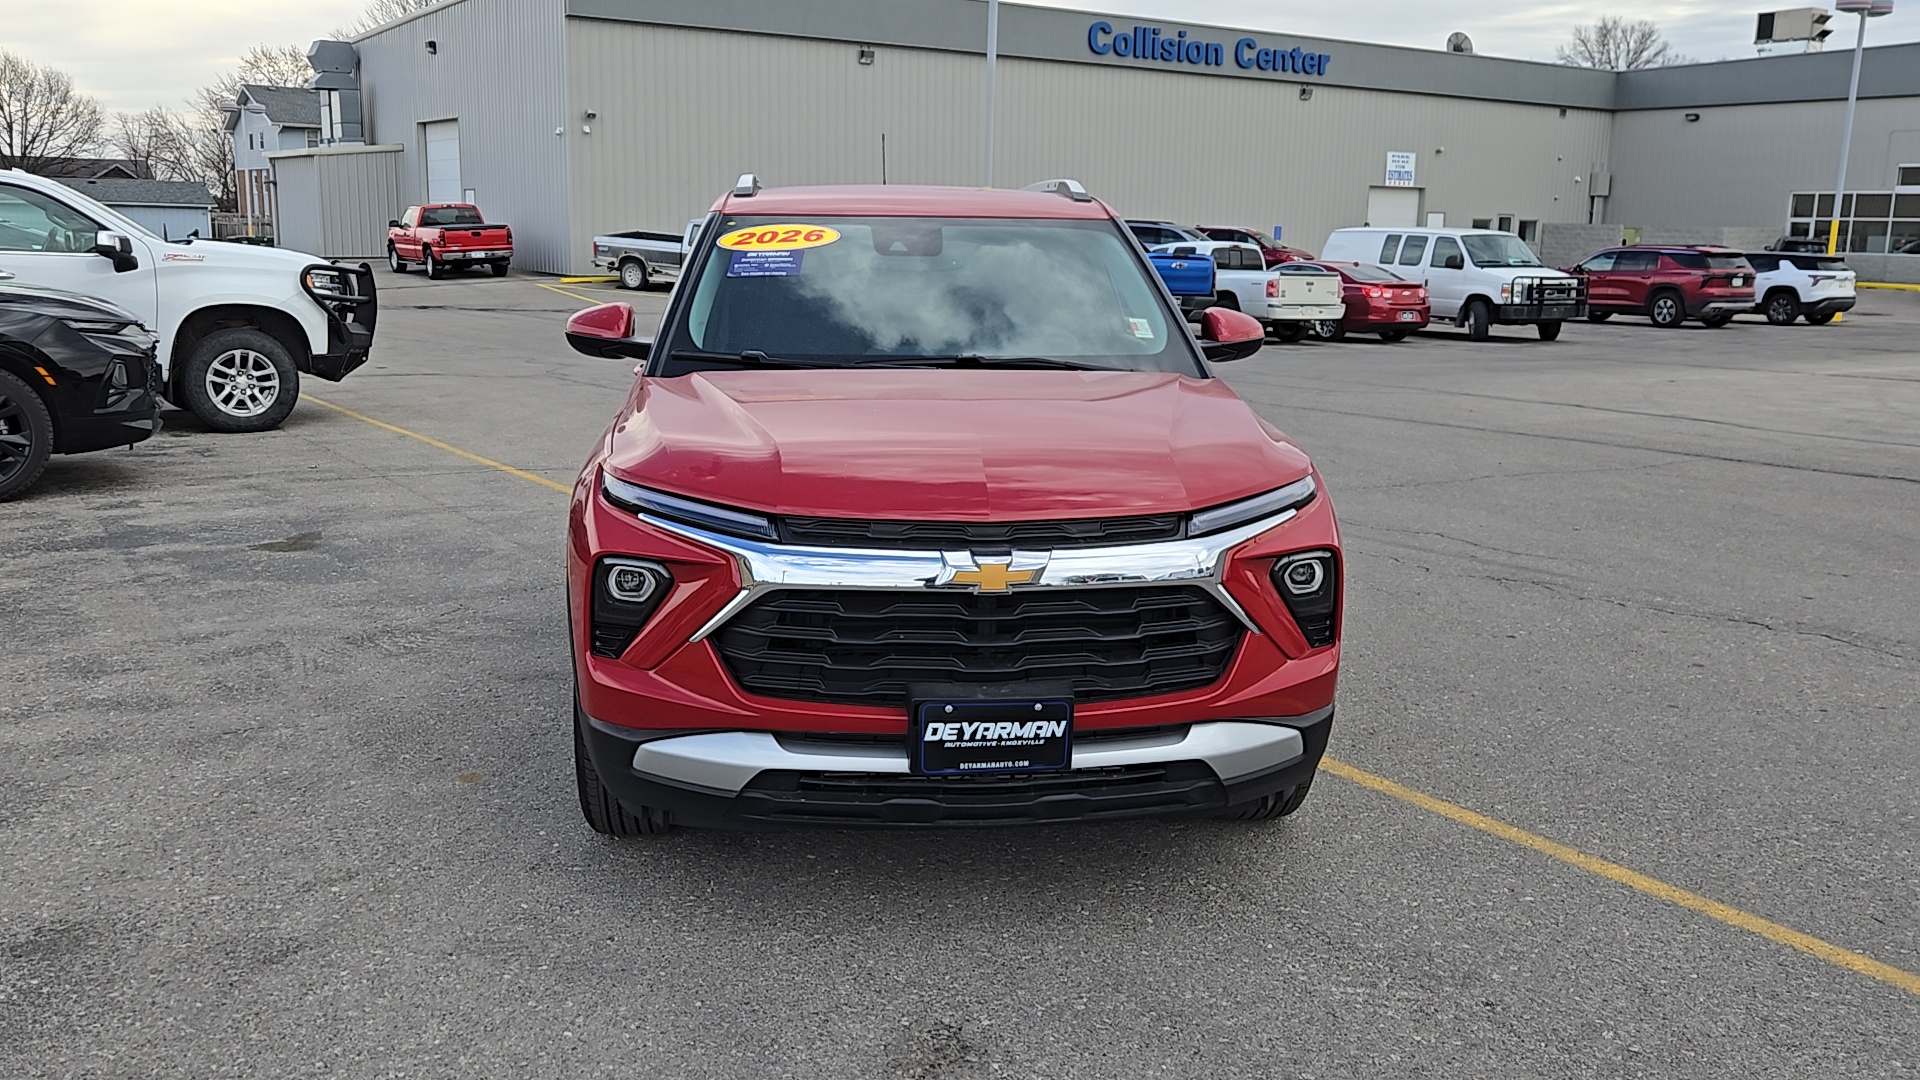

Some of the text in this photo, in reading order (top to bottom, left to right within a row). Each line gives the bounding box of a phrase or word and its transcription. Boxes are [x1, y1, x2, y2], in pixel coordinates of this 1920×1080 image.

[1088, 20, 1331, 76] Collision Center
[730, 229, 826, 247] 2026
[923, 720, 1067, 742] DEYARMAN
[959, 760, 1030, 770] DEYARMANAUTO.COM
